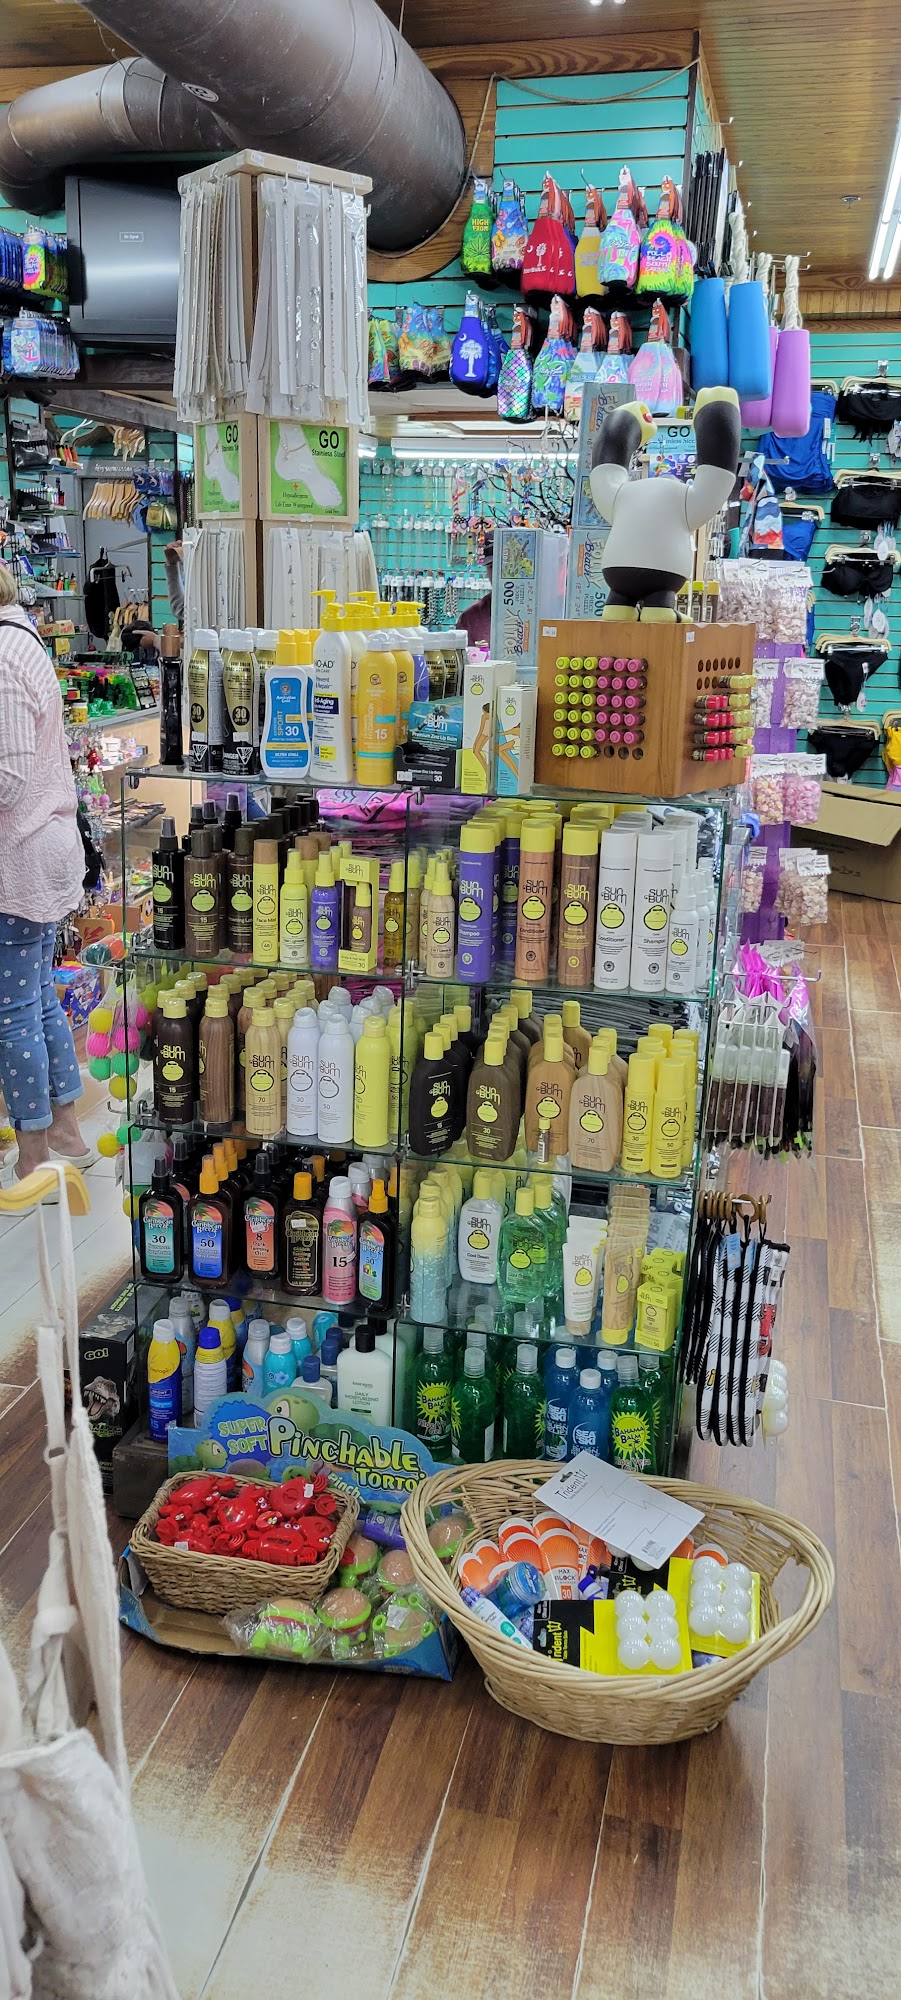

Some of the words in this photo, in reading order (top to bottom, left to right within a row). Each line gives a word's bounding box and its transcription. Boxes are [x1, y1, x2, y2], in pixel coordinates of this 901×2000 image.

[225, 425, 239, 444] GO
[667, 425, 690, 438] GO
[318, 430, 339, 449] GO
[311, 448, 333, 458] Stainless
[503, 581, 515, 606] 500
[594, 591, 606, 617] 500
[235, 707, 247, 717] 30
[285, 725, 300, 737] 30
[374, 728, 388, 740] 15
[411, 731, 430, 739] Premium
[433, 775, 443, 783] 30
[482, 1127, 491, 1135] 30
[143, 1216, 174, 1226] Caribbean
[191, 1219, 222, 1230] Caribbean
[151, 1234, 166, 1244] 30
[256, 1232, 263, 1241] 8
[200, 1238, 215, 1248] 50
[332, 1256, 348, 1268] 15
[84, 1347, 109, 1361] GO!
[548, 1405, 567, 1414] SEA
[218, 1416, 268, 1438] SUPER
[614, 1426, 644, 1437] BAHAMA
[575, 1429, 596, 1438] SEA
[620, 1434, 642, 1444] BALM
[227, 1434, 268, 1455] SOFT
[555, 1475, 583, 1500] Trident
[561, 1588, 572, 1599] 30
